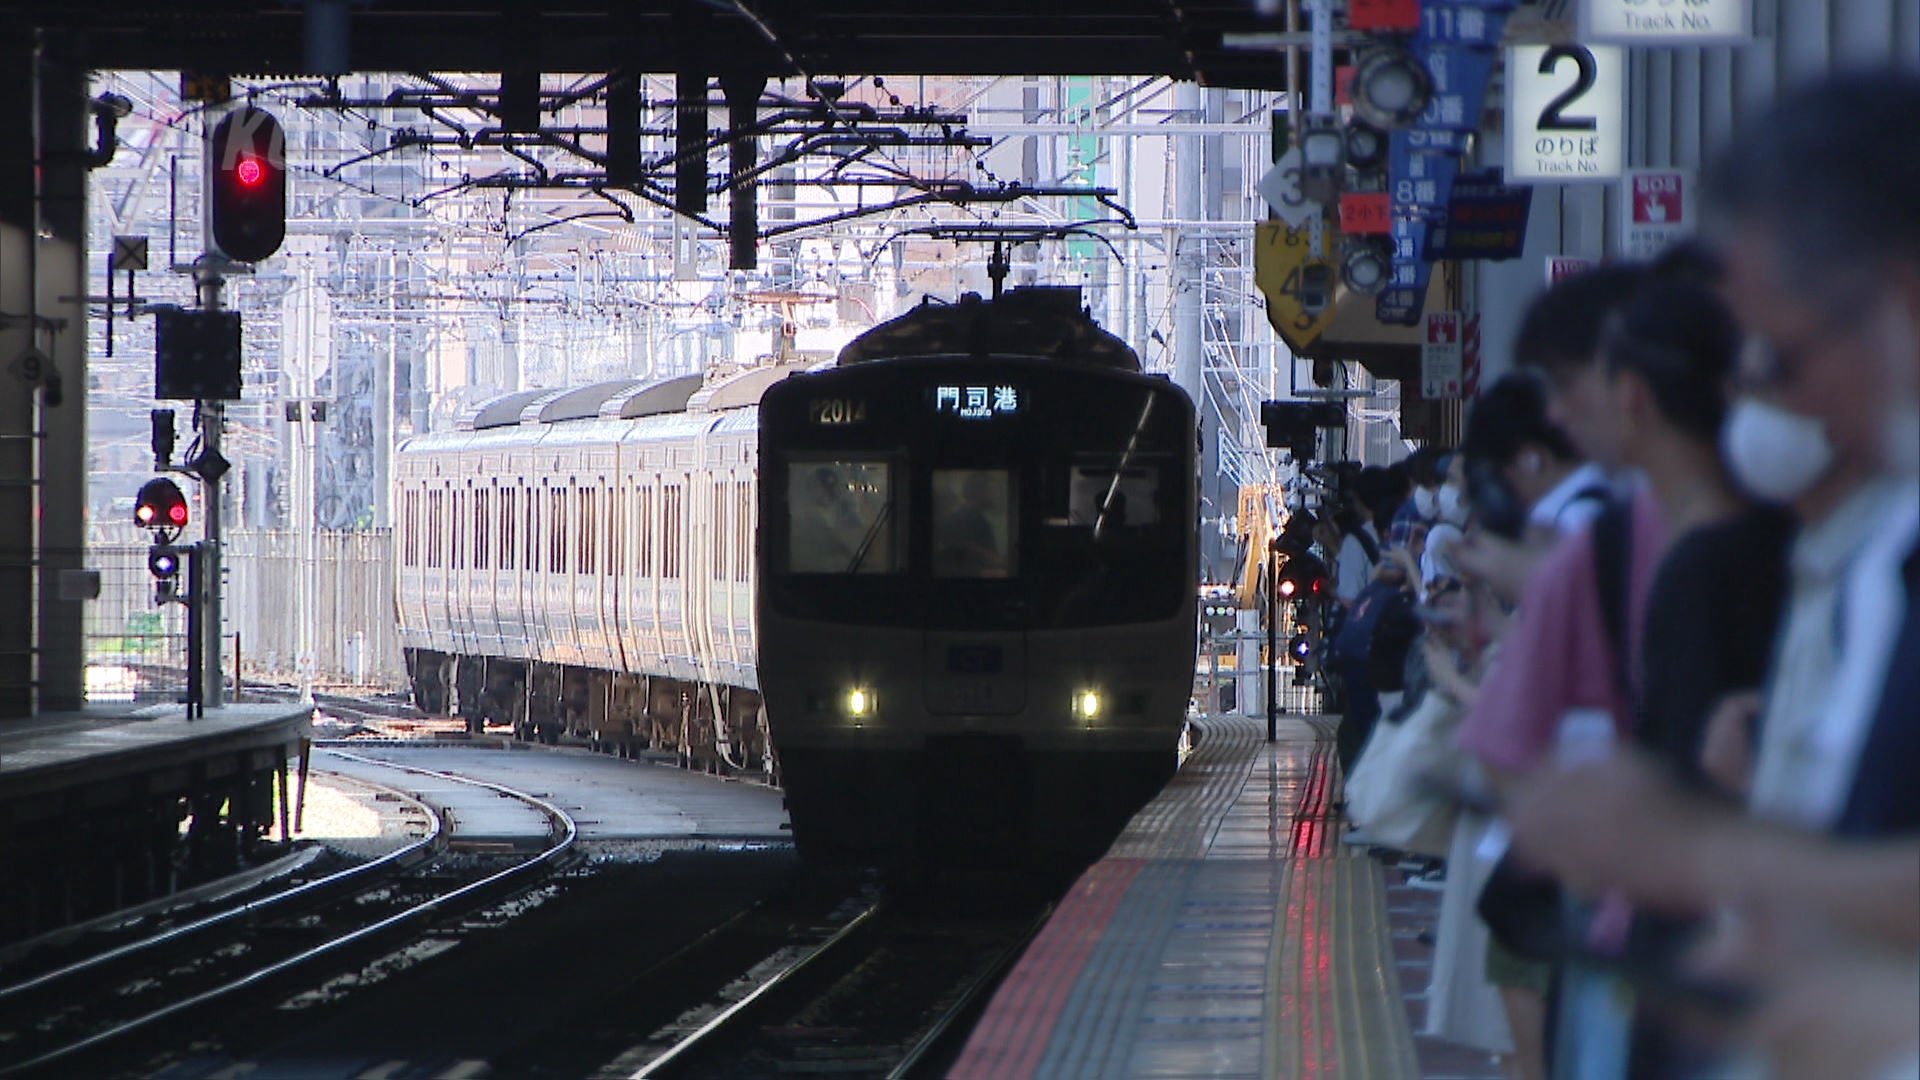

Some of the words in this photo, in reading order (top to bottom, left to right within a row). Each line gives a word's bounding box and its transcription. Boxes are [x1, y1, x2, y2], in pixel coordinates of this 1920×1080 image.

[1624, 11, 1674, 29] Track
[1536, 44, 1598, 132] 2
[1535, 136, 1599, 157] のりば
[1536, 159, 1573, 173] Track
[1637, 175, 1677, 193] SOS
[23, 356, 41, 381] 9
[937, 386, 1017, 410] 門司港
